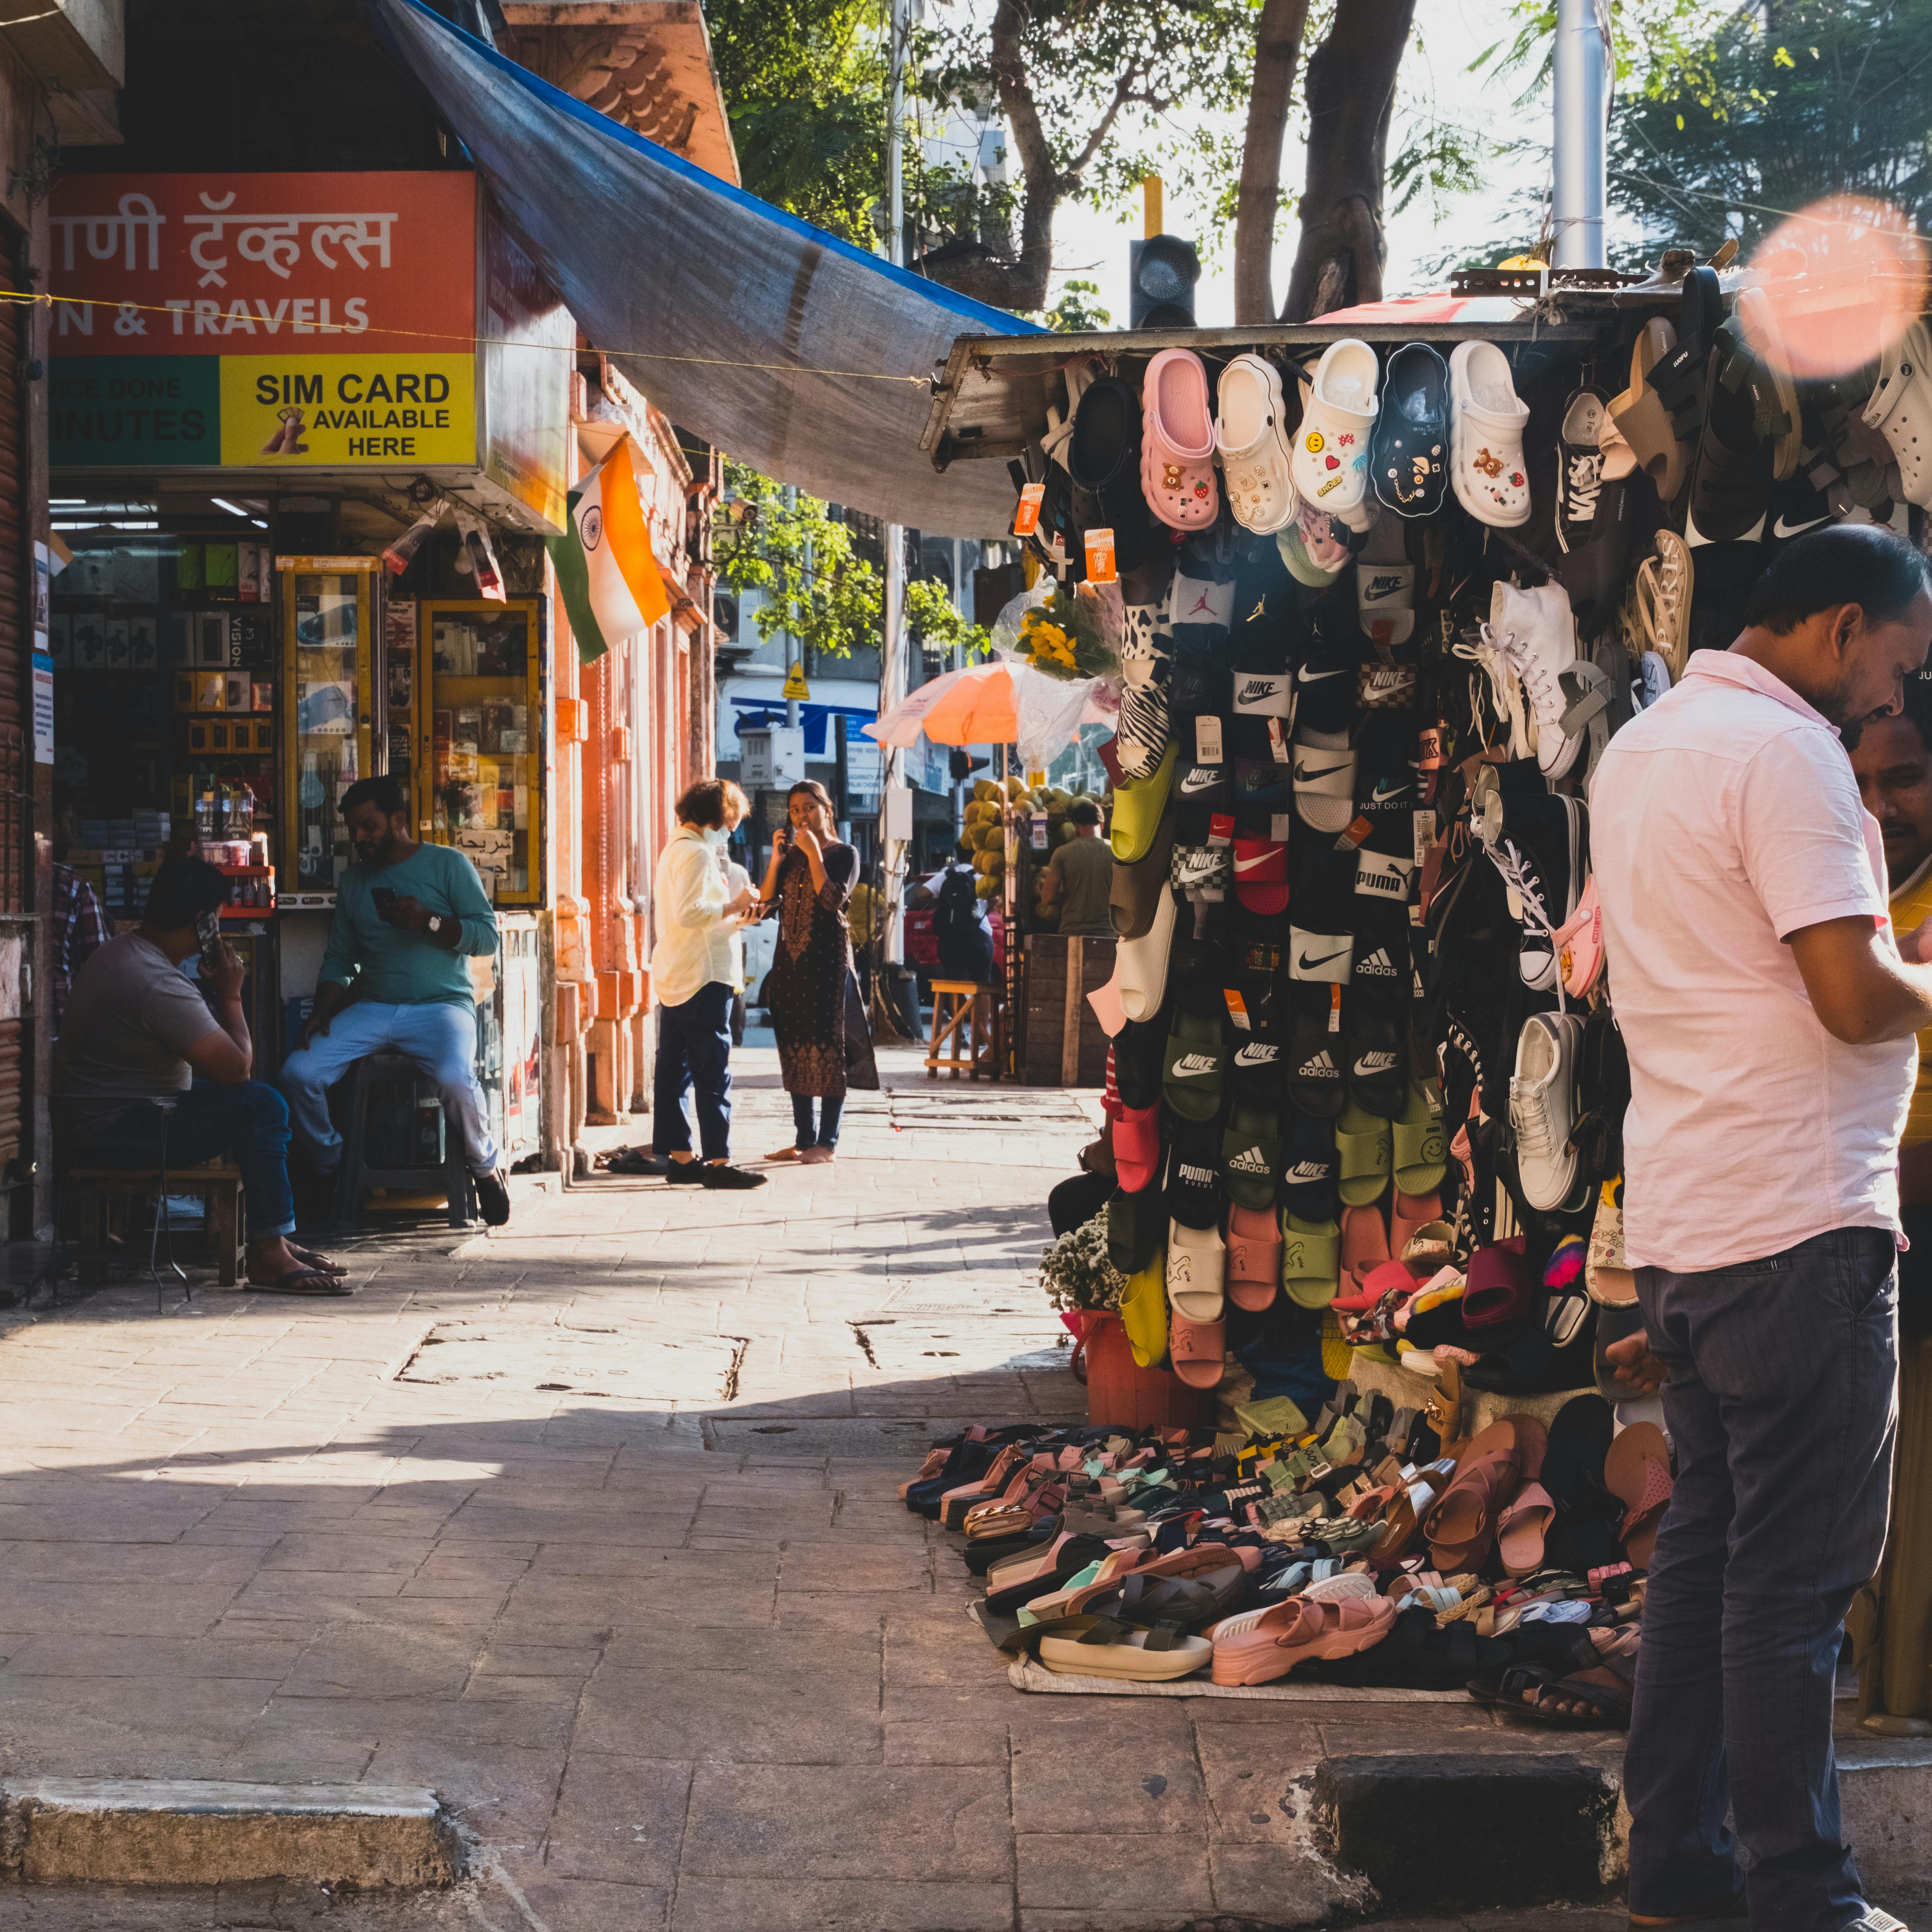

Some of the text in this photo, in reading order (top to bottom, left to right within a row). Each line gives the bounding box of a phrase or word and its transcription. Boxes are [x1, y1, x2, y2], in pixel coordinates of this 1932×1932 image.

[50, 297, 369, 336] N & TRAVELS
[1673, 351, 1688, 368] LUOFU
[109, 378, 182, 399] DONE
[255, 373, 450, 405] SIM CARD
[313, 409, 450, 430] AVAILABLE
[348, 436, 416, 457] HERE
[1317, 476, 1343, 497] SHOES
[1370, 576, 1402, 590] NIKE
[231, 617, 242, 667] VISION
[1372, 671, 1406, 686] NIKE
[1244, 680, 1275, 695] NIKE
[1187, 768, 1218, 783] NIKE
[1250, 768, 1281, 782] NIKE
[1360, 802, 1382, 810] JUST
[1188, 853, 1221, 868] NIKE
[1356, 871, 1401, 892] PUMA
[1356, 963, 1397, 977] adidas
[1243, 1042, 1279, 1059] NIKE
[1181, 1053, 1217, 1070] NIKE
[1362, 1051, 1397, 1067] NIKE
[1299, 1066, 1340, 1078] adidas
[1178, 1163, 1214, 1183] PUMA
[1229, 1159, 1270, 1174] adidas
[1294, 1161, 1330, 1177] NIKE
[1185, 1179, 1214, 1189] SUEDE
